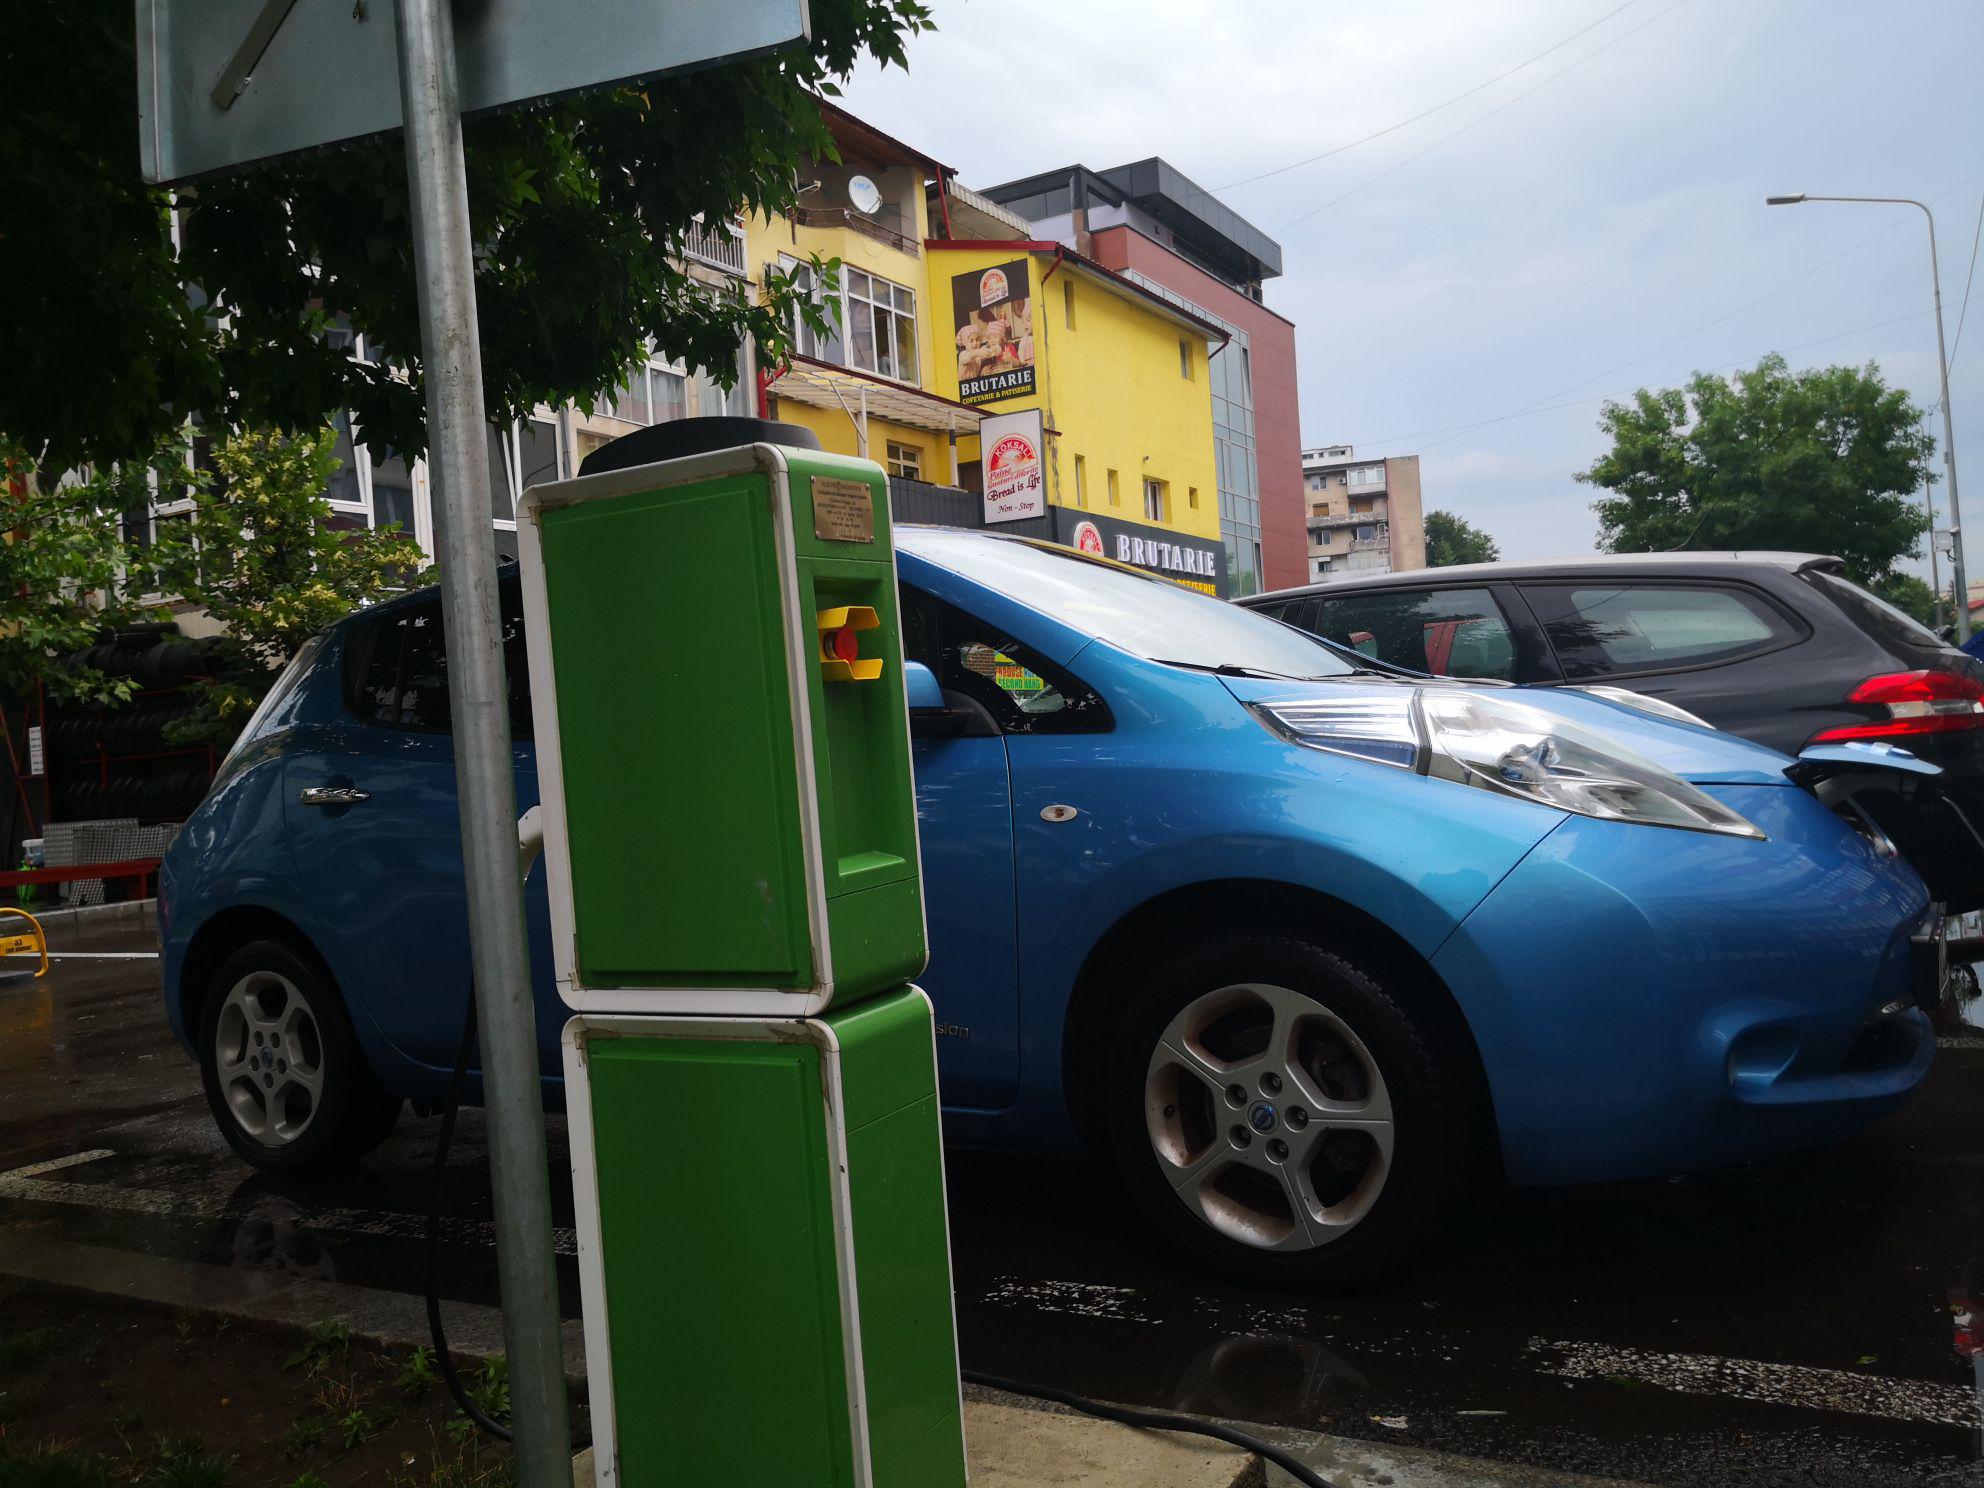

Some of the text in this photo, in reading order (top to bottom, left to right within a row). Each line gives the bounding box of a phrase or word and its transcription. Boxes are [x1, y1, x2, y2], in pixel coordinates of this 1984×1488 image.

[961, 370, 1032, 395] BRUTARIE
[1001, 385, 1032, 397] PATISERIE
[986, 472, 1041, 502] Bread is Life
[997, 504, 1013, 514] Non
[1018, 501, 1035, 512] Stop
[1114, 534, 1216, 577] BRUTARIE
